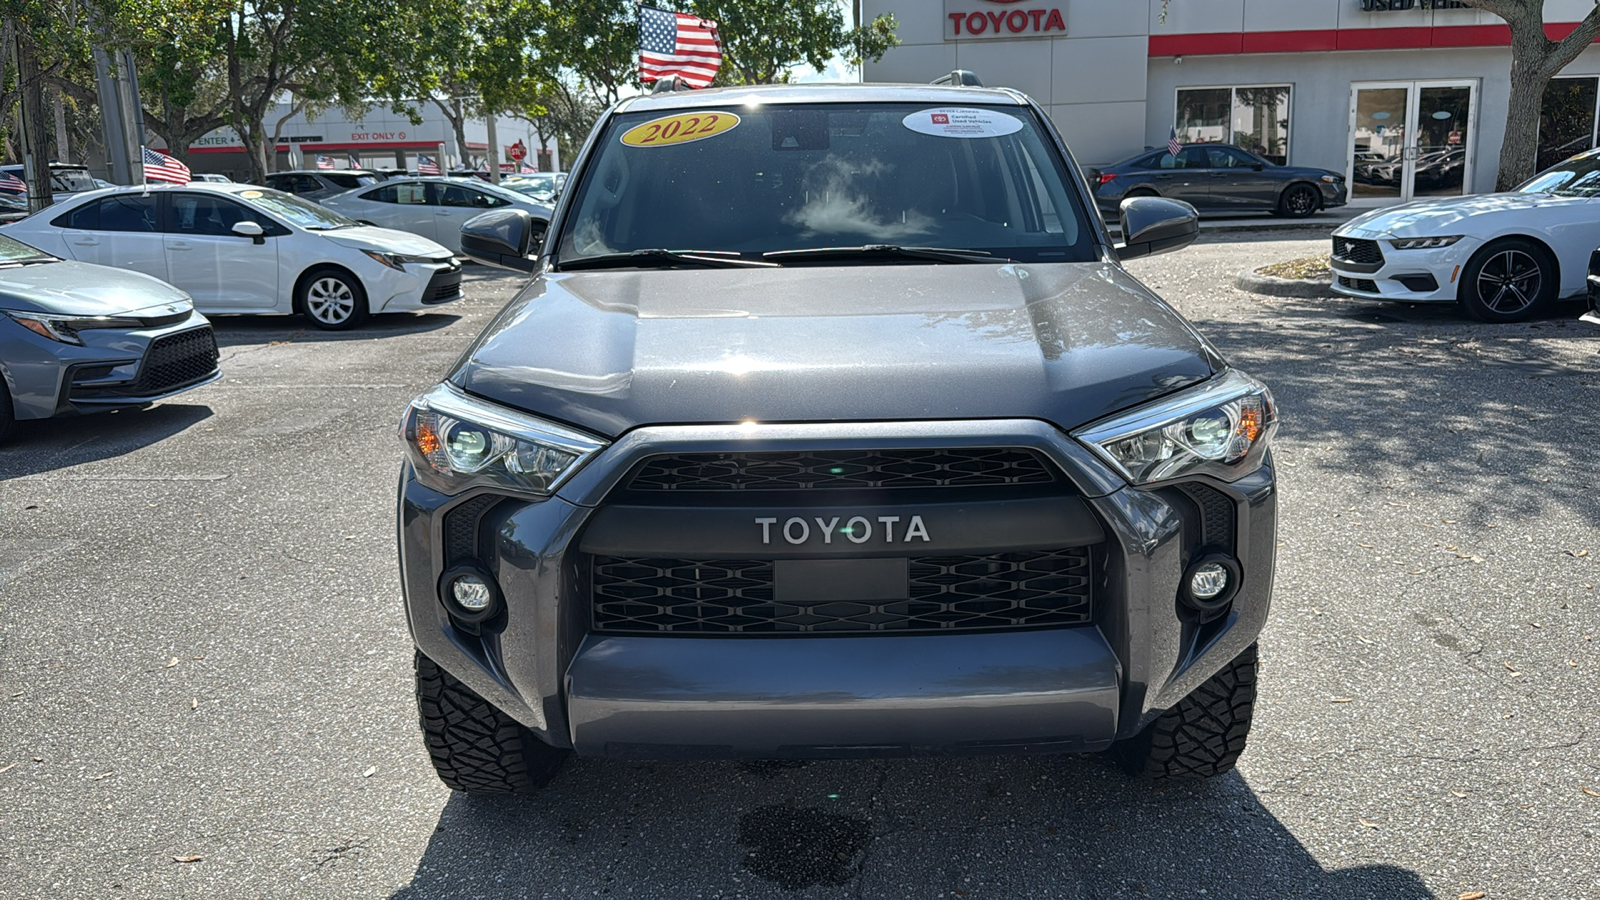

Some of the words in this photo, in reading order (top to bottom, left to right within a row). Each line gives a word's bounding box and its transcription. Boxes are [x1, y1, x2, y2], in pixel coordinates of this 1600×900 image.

[948, 8, 1066, 35] TOYOTA
[199, 137, 228, 145] ENTER
[372, 132, 395, 140] ONLY
[640, 115, 719, 143] 2022
[755, 515, 931, 545] TOYOTA
